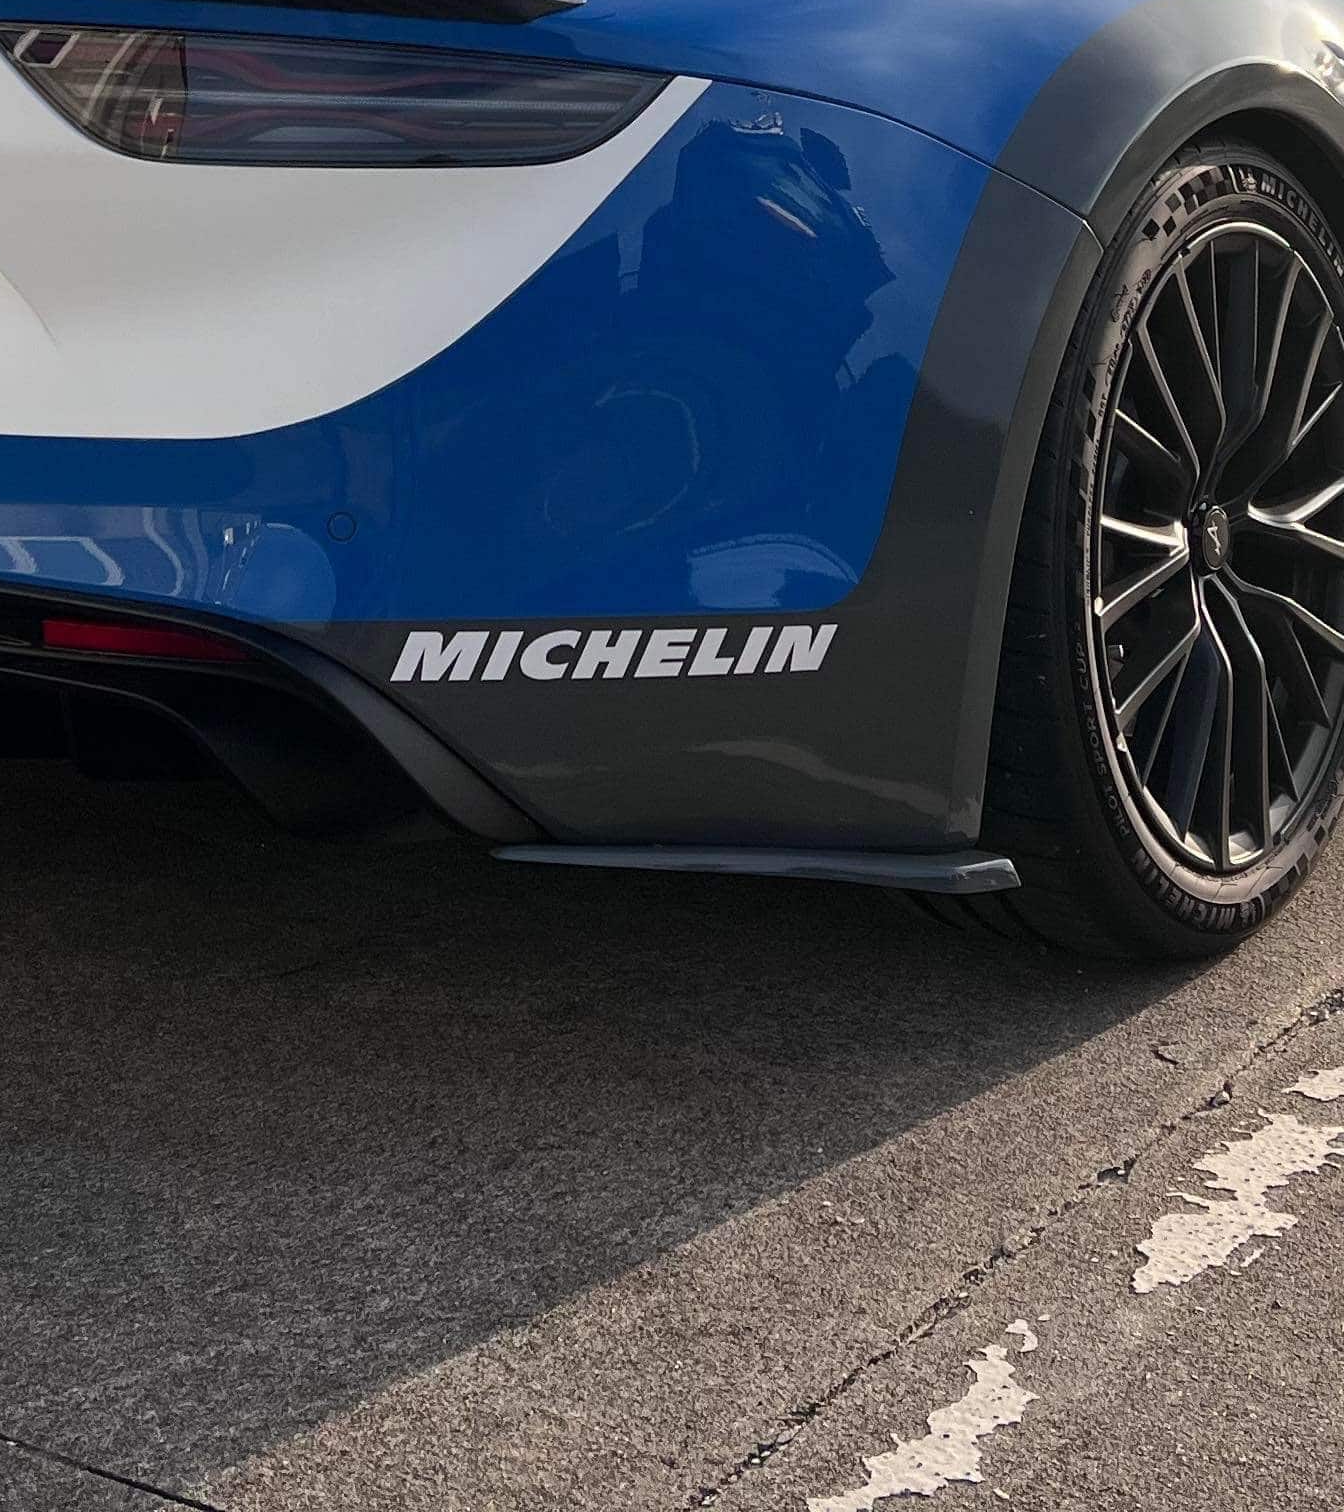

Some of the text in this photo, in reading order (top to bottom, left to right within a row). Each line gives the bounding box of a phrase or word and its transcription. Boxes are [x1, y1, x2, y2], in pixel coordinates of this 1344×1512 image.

[1261, 172, 1344, 278] MICHELIN
[390, 624, 839, 682] MICHELIN
[1074, 642, 1090, 690] CUP
[1082, 702, 1107, 776] SPORT
[1134, 847, 1237, 930] MICHELIN
